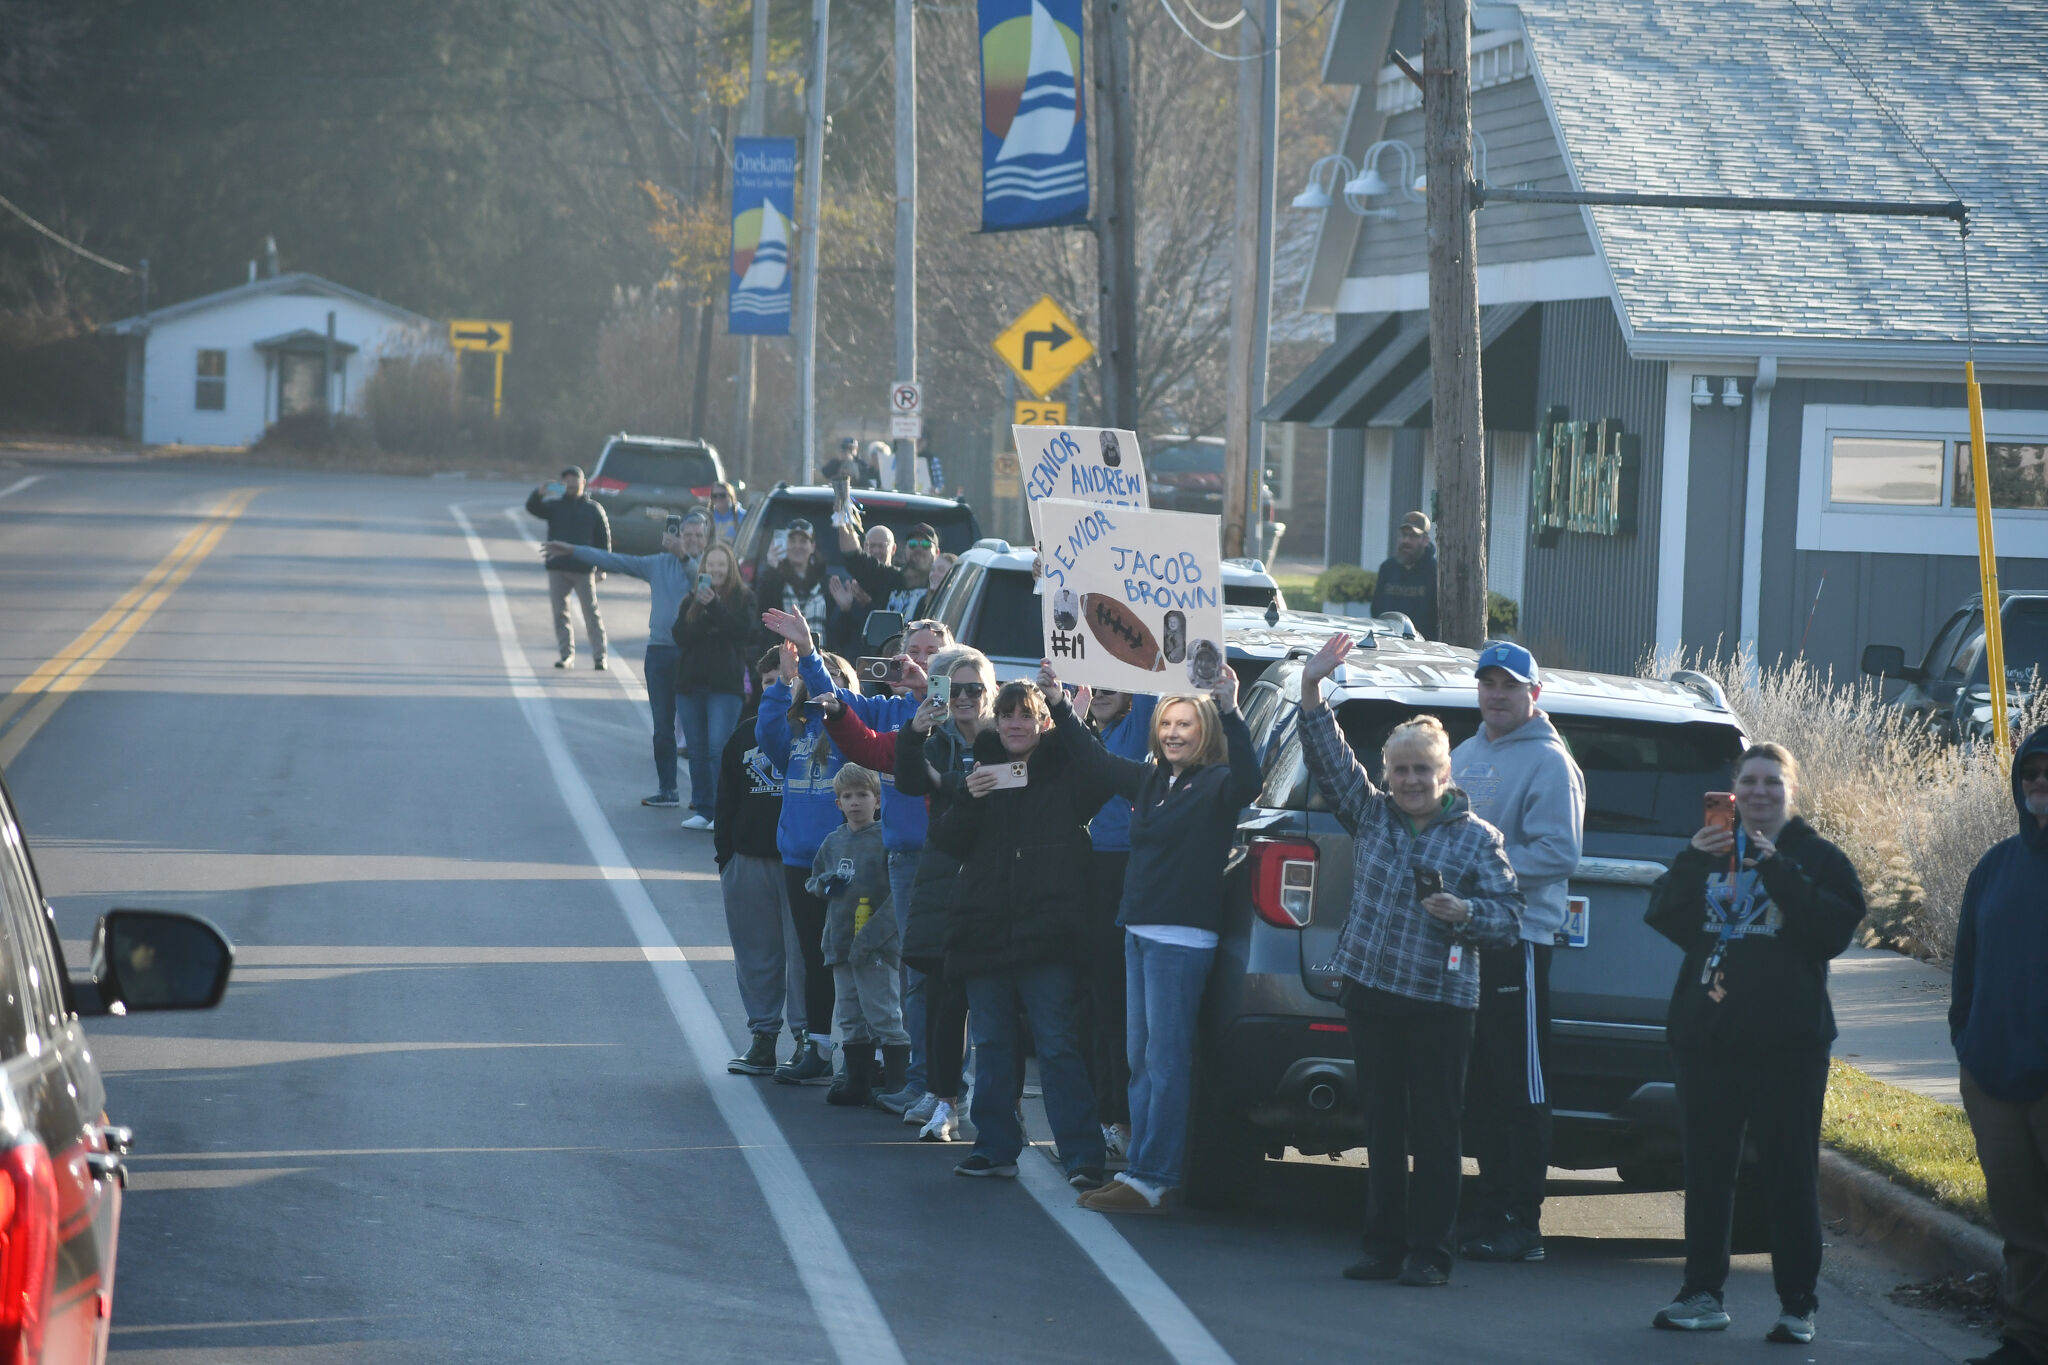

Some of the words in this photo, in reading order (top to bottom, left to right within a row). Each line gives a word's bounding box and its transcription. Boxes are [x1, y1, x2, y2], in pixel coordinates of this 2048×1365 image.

[734, 151, 794, 172] Onekama
[1021, 409, 1060, 425] 25
[1071, 463, 1141, 496] ANDREW
[1045, 510, 1116, 588] SENIOR
[1110, 546, 1202, 585] JACOB
[1124, 578, 1217, 609] BROWN
[1051, 630, 1085, 660] #19
